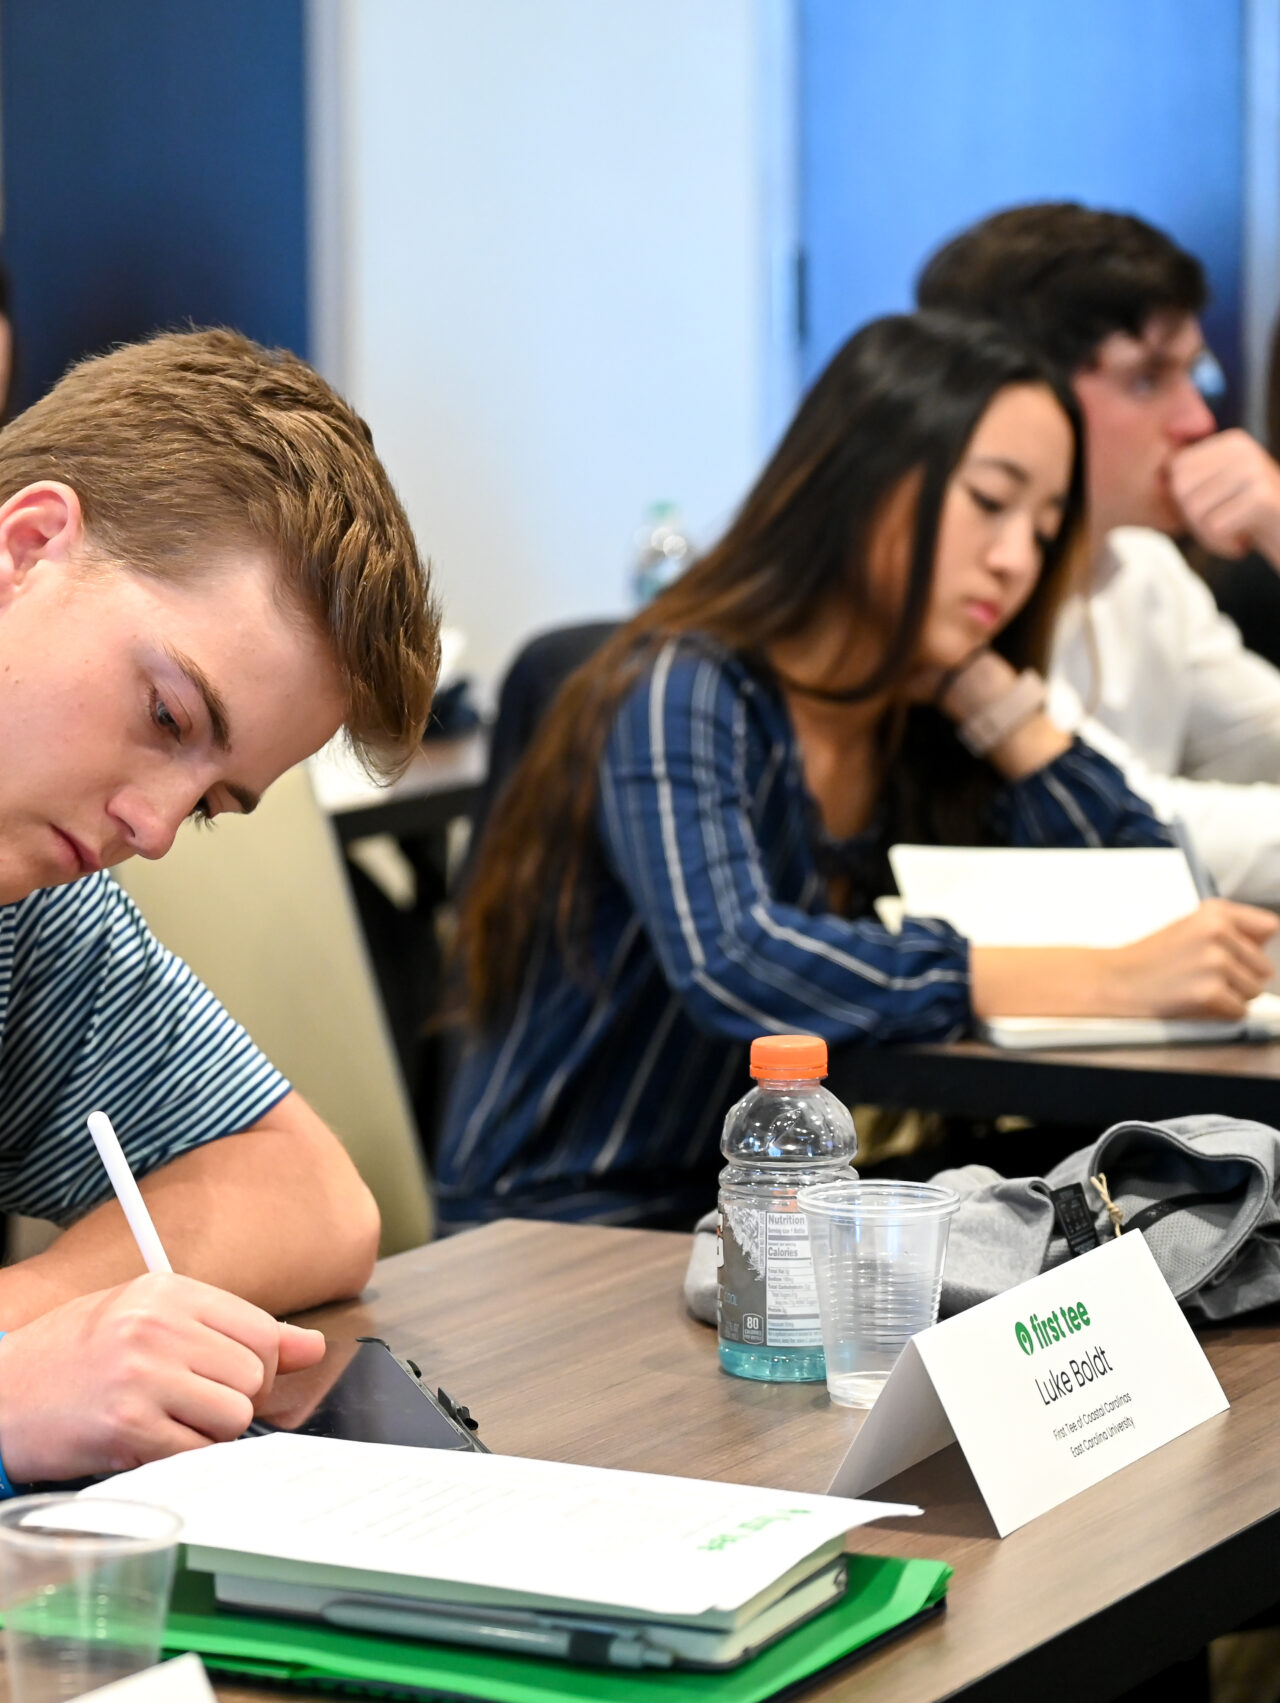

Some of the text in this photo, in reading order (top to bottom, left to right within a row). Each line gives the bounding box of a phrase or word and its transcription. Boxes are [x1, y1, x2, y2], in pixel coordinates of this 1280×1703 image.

[768, 1214, 805, 1225] Nutrition
[768, 1246, 798, 1257] Calories
[746, 1316, 759, 1330] 80
[1029, 1301, 1091, 1349] first tee
[1034, 1345, 1114, 1405] Luke Boldt
[1052, 1392, 1132, 1441] First Tee of Coastal Carolinas
[1070, 1416, 1136, 1458] East Carolina University
